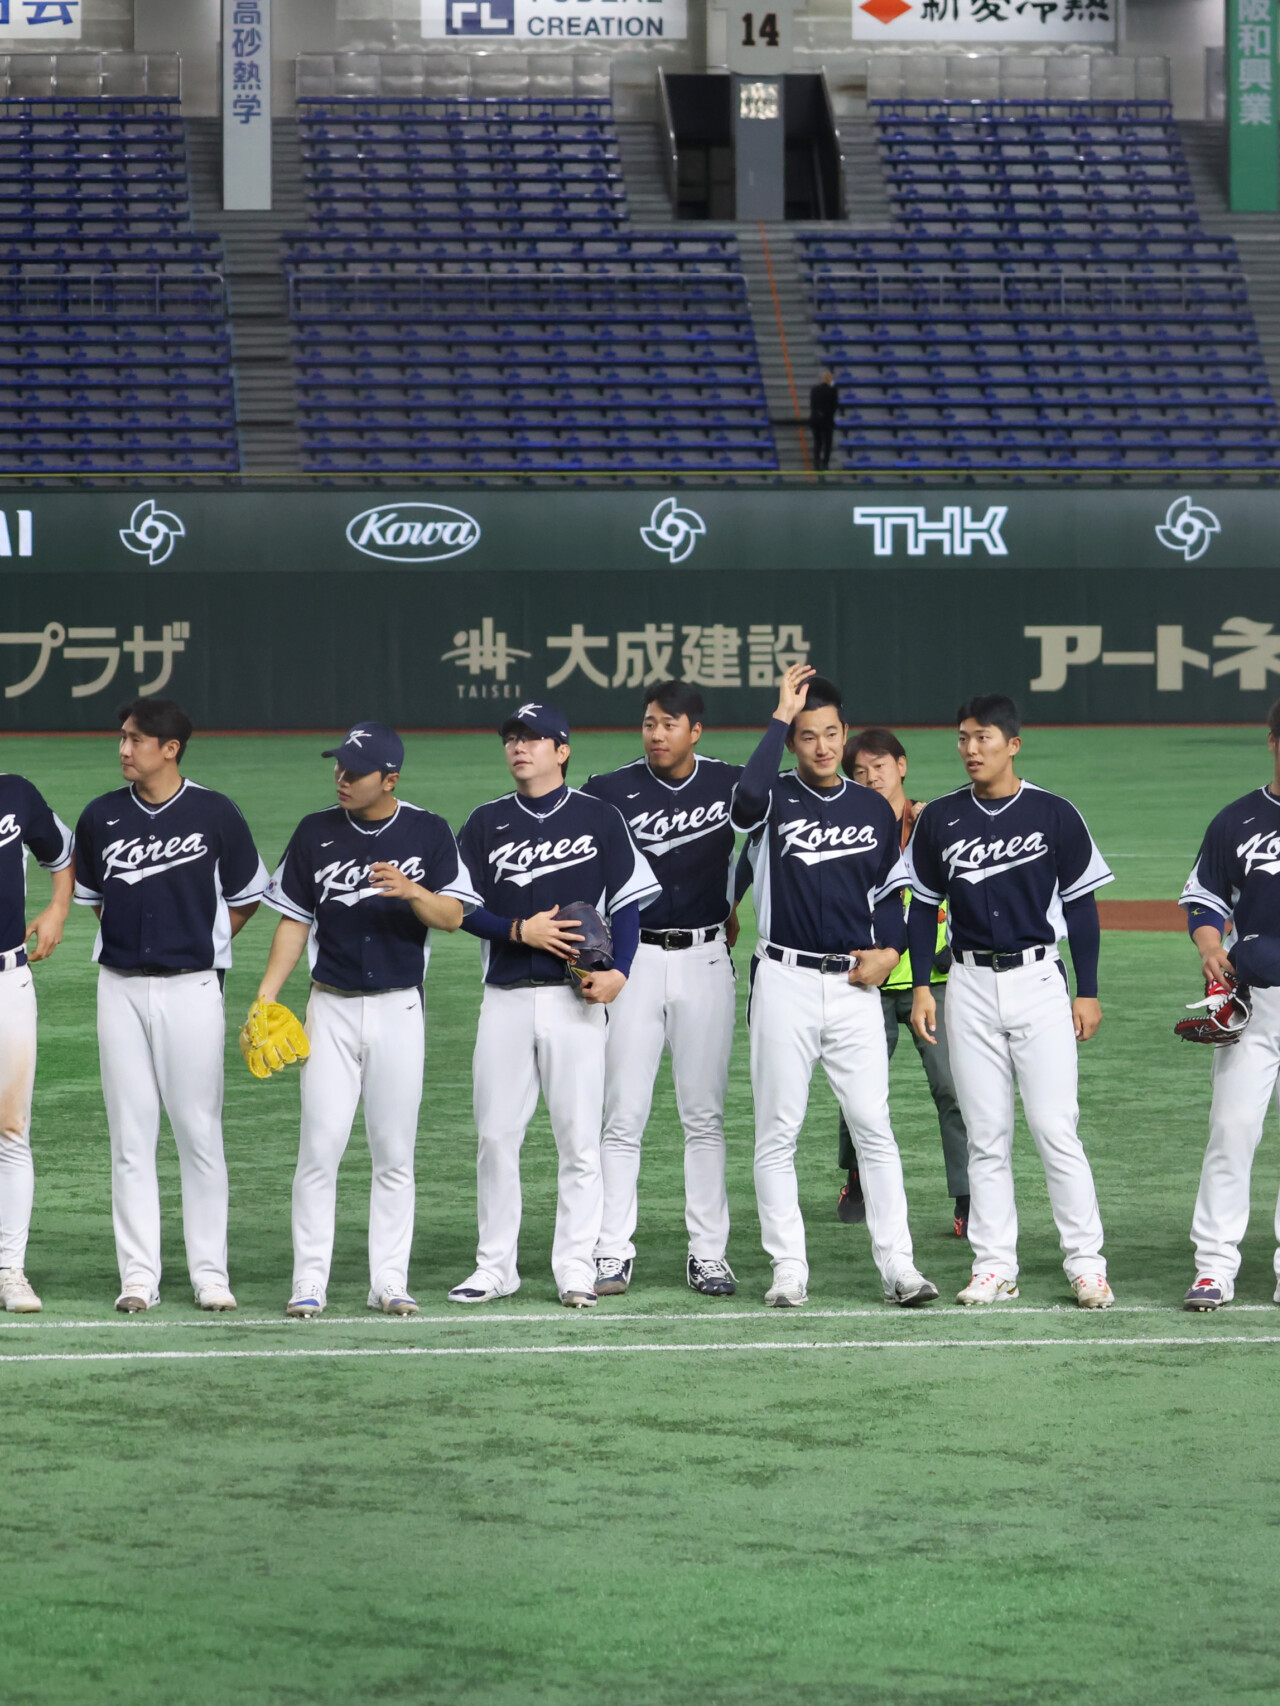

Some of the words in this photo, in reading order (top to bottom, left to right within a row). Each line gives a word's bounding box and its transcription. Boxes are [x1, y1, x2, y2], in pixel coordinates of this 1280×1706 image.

[527, 16, 663, 36] CREATION
[742, 13, 779, 46] 14
[357, 512, 475, 546] Kowa
[854, 506, 1008, 555] THK
[0, 620, 190, 698] プラザ
[546, 622, 811, 688] 大成建設
[457, 684, 520, 699] TAISEI
[628, 801, 730, 856] Korea
[778, 818, 878, 866] Korea
[102, 832, 208, 885] Korea
[488, 834, 598, 887] Korea
[942, 831, 1049, 885] Korea
